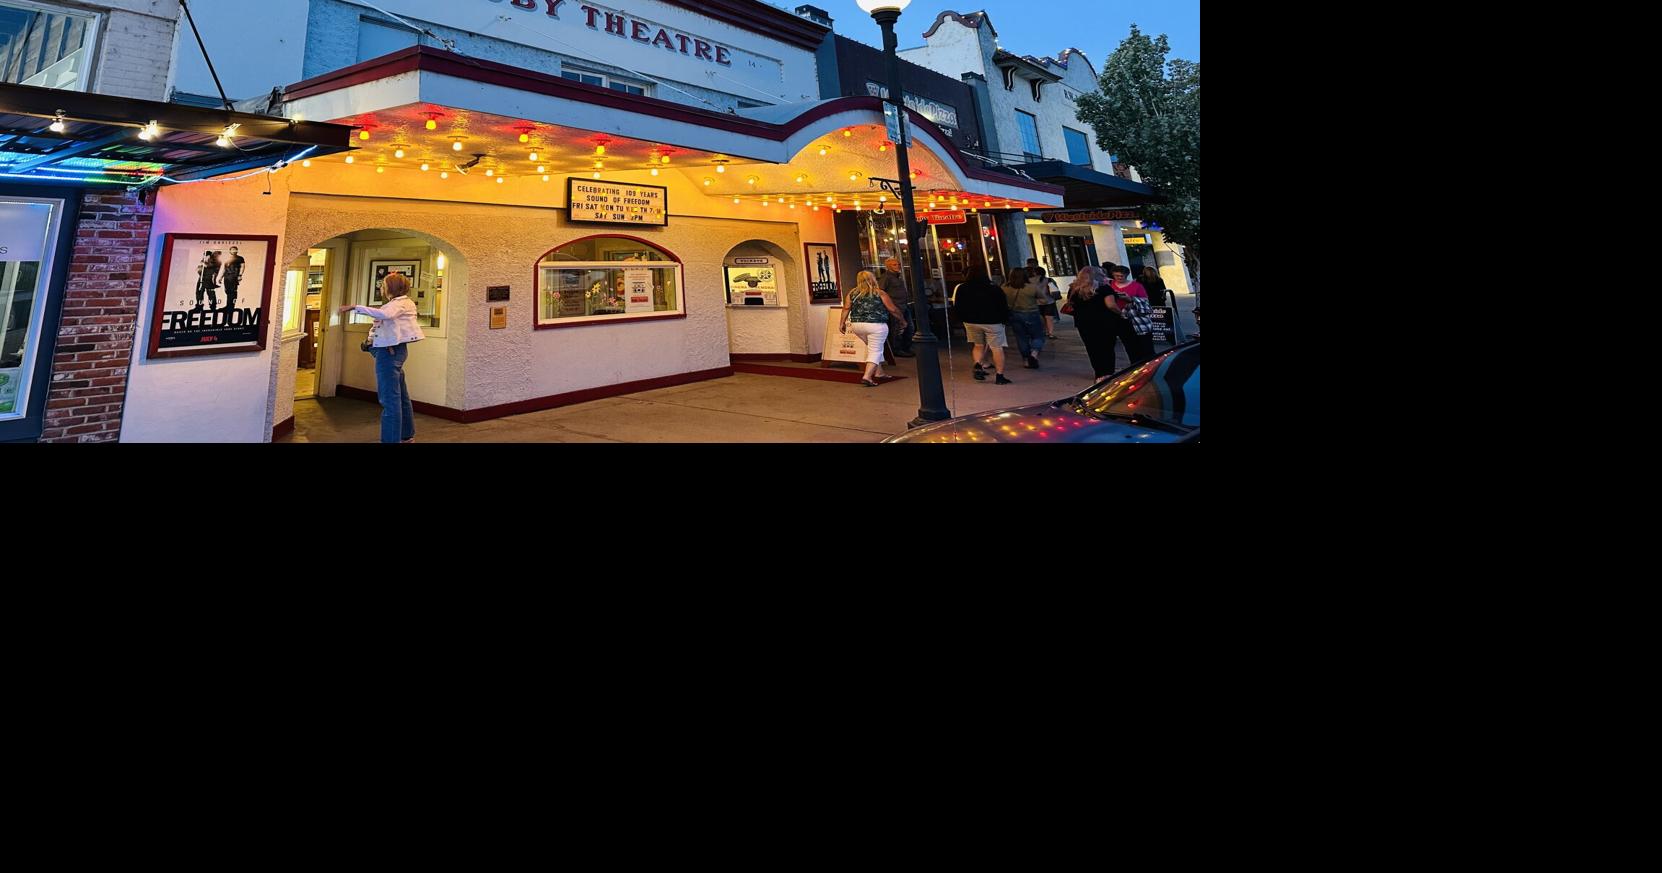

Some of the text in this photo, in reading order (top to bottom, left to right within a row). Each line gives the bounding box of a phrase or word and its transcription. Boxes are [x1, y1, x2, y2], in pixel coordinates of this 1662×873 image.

[580, 5, 732, 67] THEATRE
[577, 185, 620, 195] CELEBRATING
[640, 191, 658, 199] YEARS
[572, 202, 583, 210] FRI
[585, 203, 598, 211] SAT
[586, 195, 608, 203] SOUND
[624, 197, 650, 206] FREEDOM
[612, 213, 625, 221] SUN
[160, 308, 261, 331] FREEDOM
